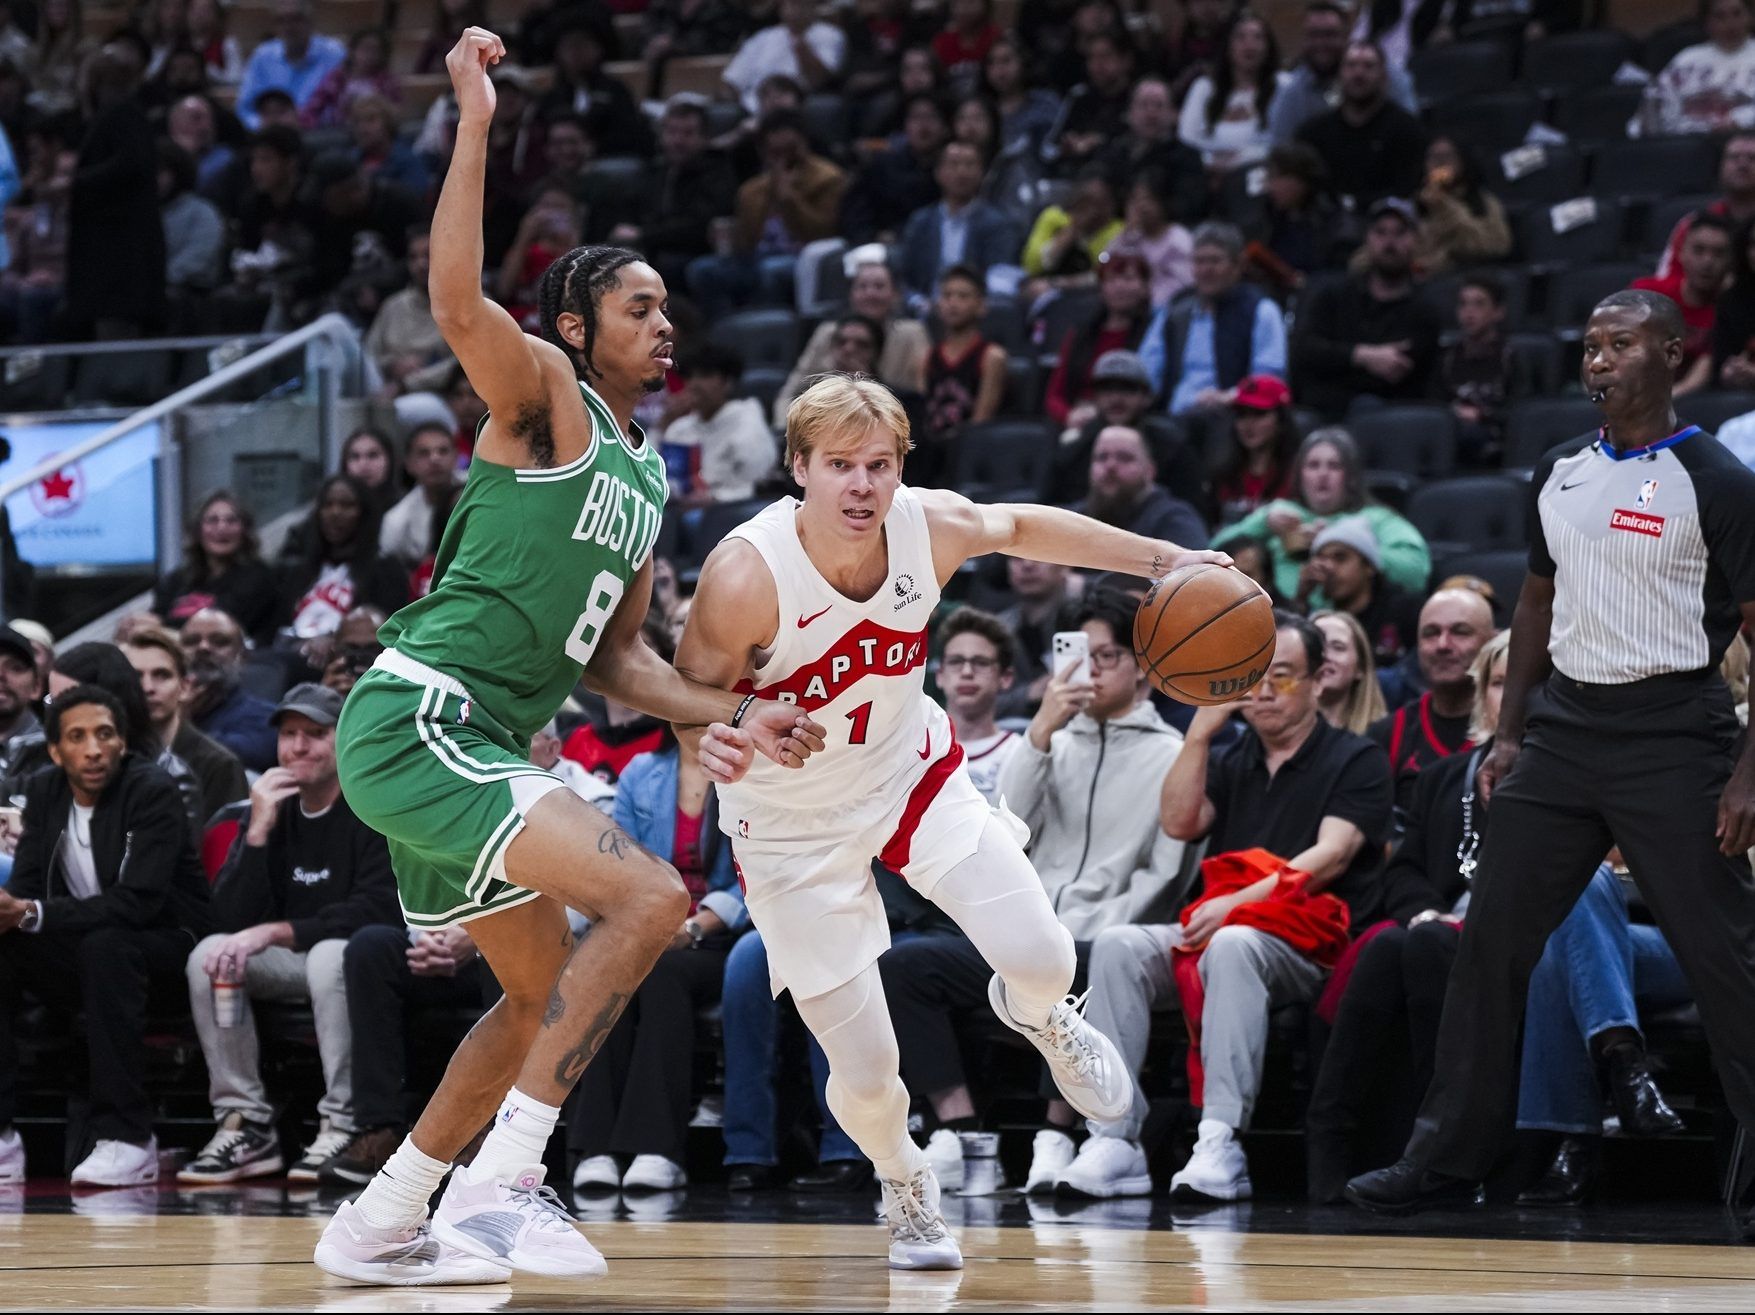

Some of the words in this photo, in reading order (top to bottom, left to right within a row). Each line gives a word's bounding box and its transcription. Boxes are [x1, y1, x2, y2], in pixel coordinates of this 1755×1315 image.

[571, 471, 663, 572] BOSTO
[1612, 512, 1662, 533] Emirates
[565, 569, 624, 666] 8
[893, 600, 906, 612] Sun
[906, 592, 921, 603] Life
[777, 636, 921, 705] APTOR
[844, 700, 873, 744] 1
